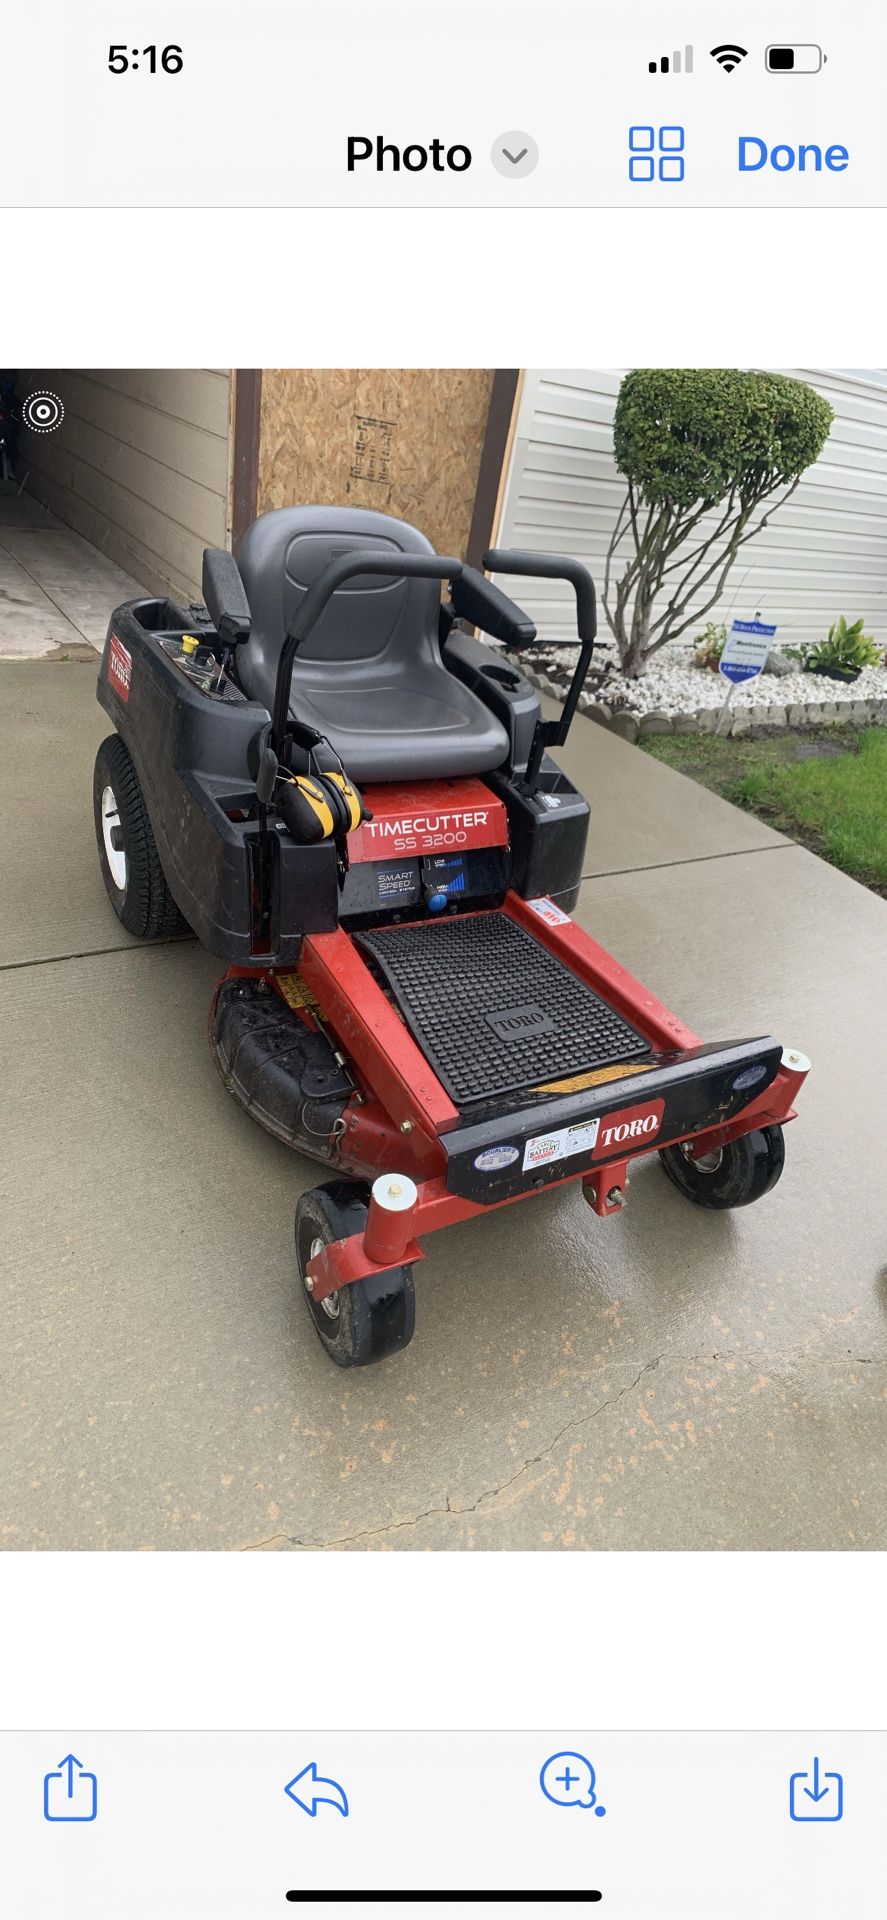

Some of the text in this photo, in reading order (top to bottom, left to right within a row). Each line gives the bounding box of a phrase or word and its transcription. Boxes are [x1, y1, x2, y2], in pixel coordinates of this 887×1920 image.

[365, 812, 487, 837] TIMECUTTER
[394, 831, 467, 851] SS 3200
[377, 871, 414, 884] SMART
[379, 880, 412, 891] SPEED
[494, 1012, 545, 1033] TORO
[601, 1114, 659, 1147] TORO
